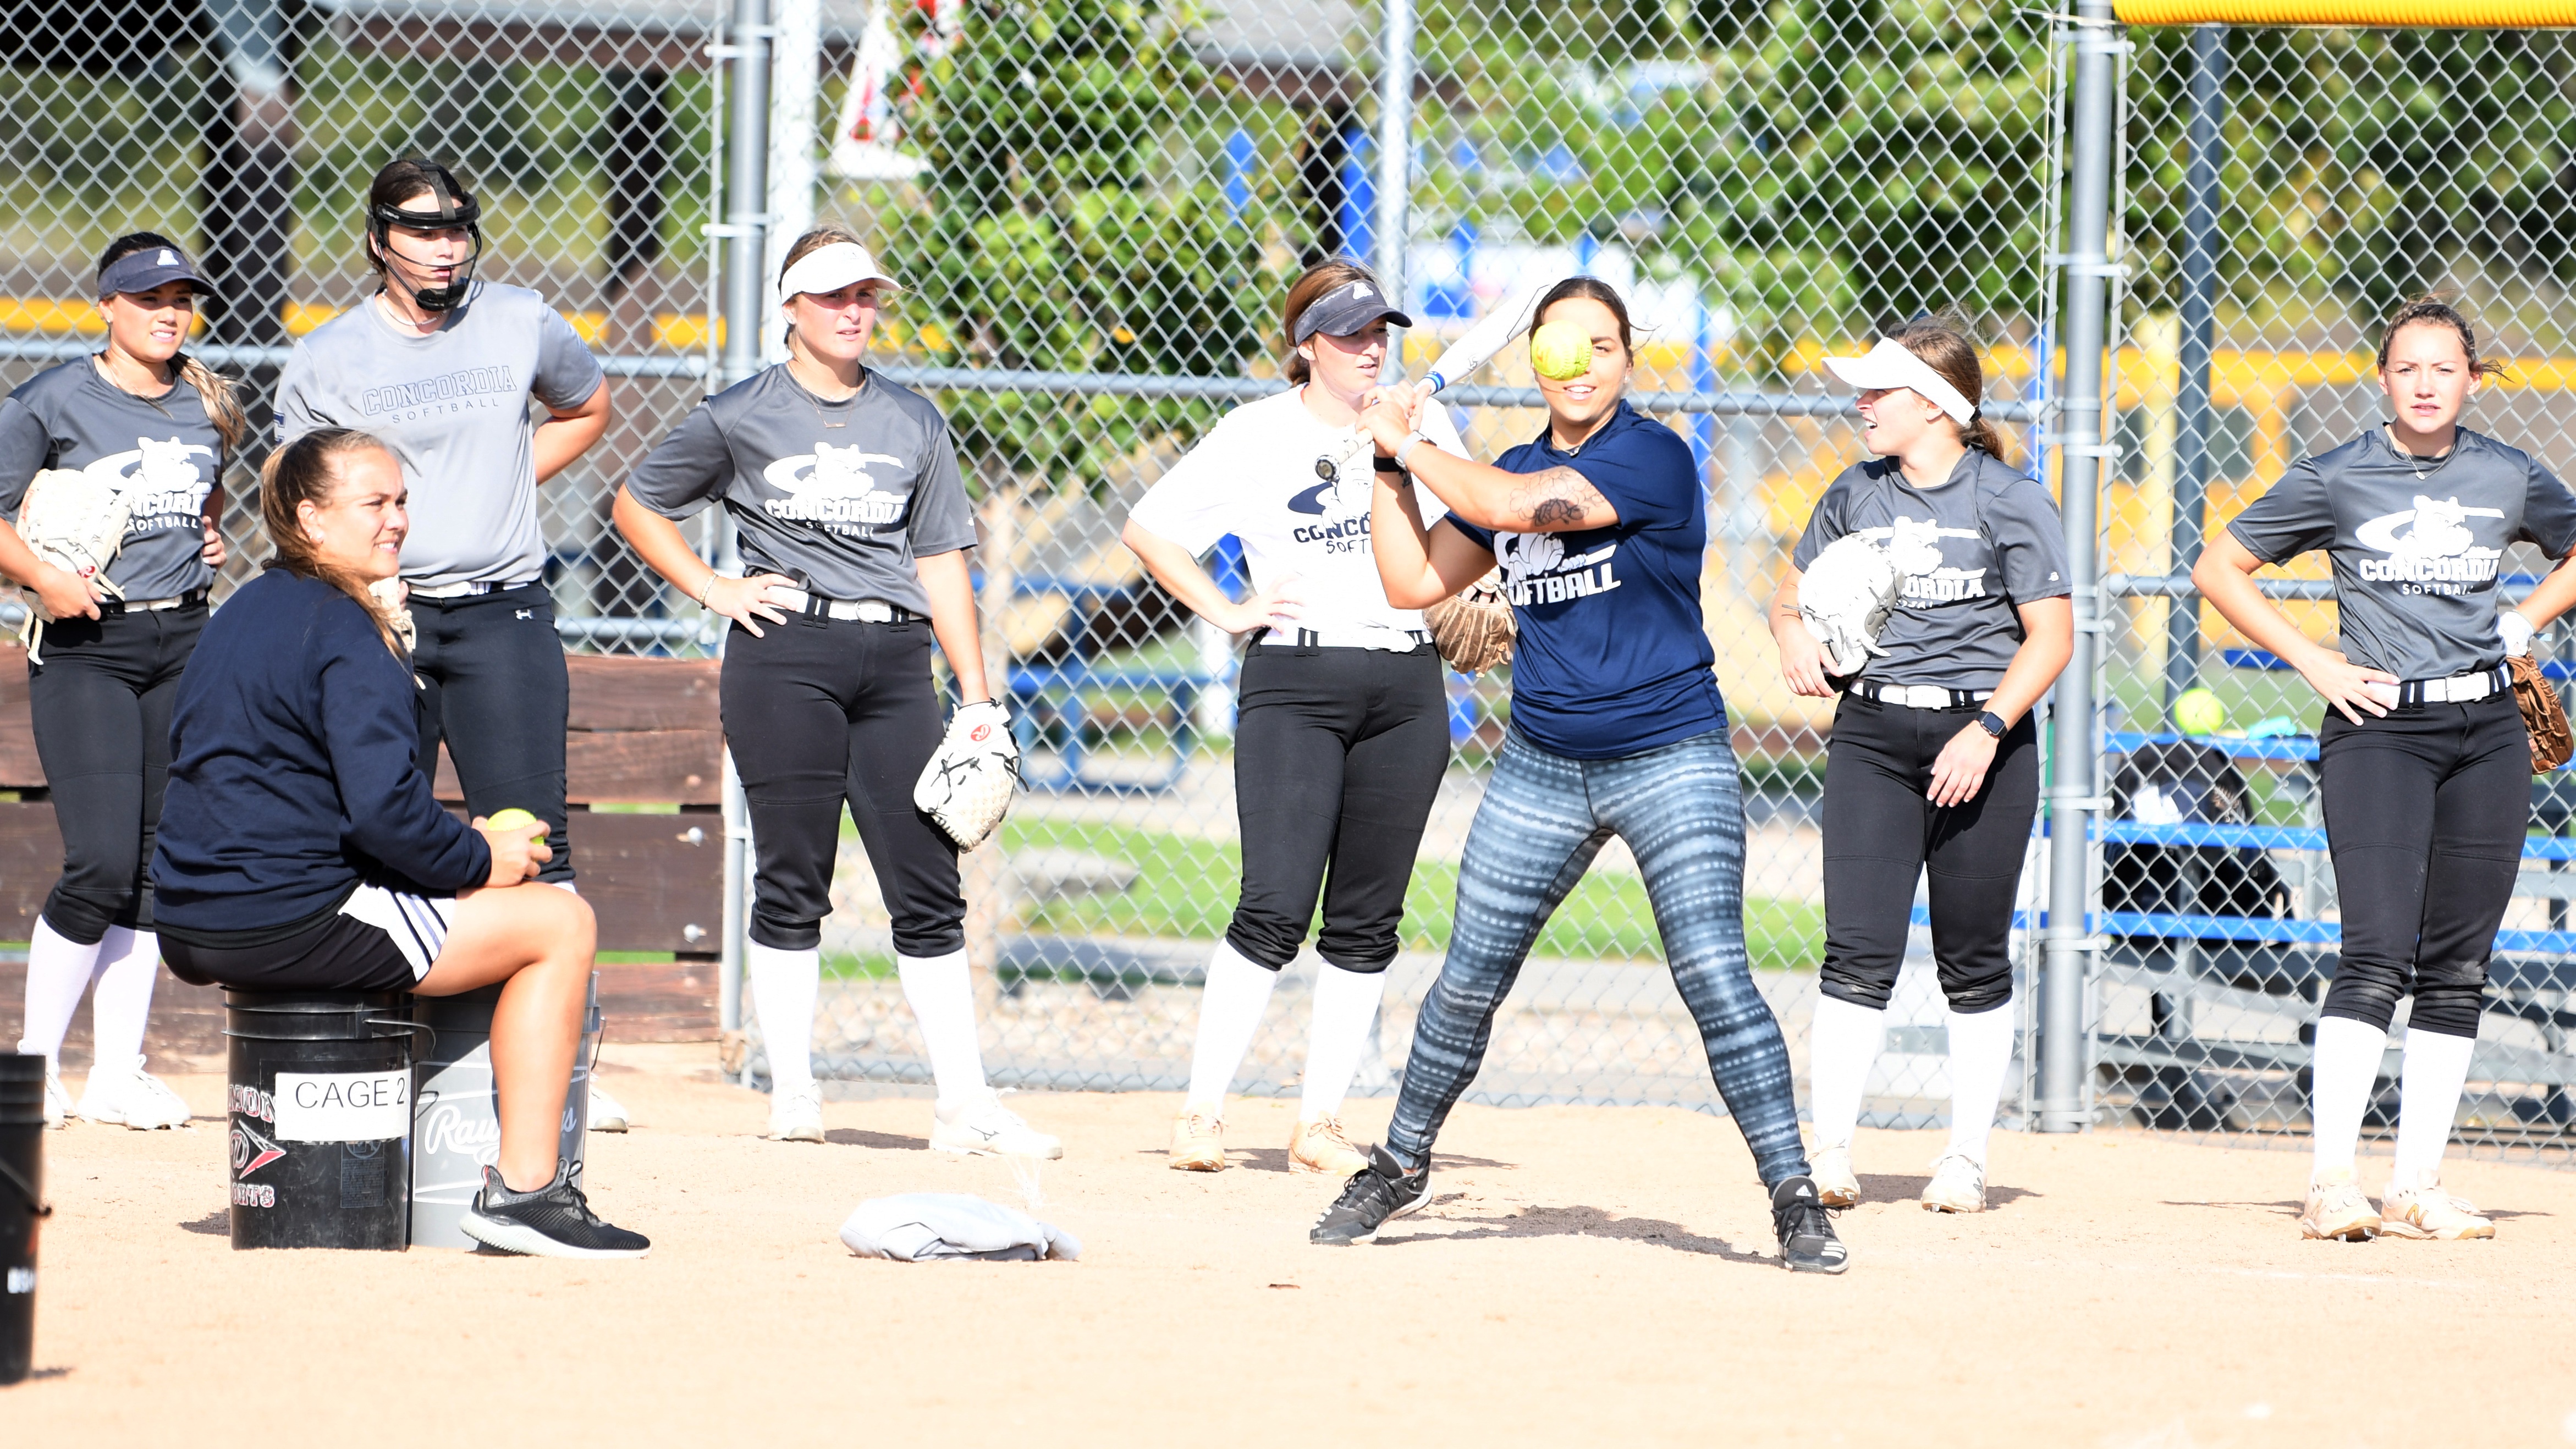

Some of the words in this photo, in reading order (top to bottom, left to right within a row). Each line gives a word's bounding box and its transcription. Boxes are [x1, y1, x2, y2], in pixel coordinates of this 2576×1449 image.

[362, 366, 518, 416] CONCORDIA
[392, 398, 499, 424] SOFTBALL
[128, 516, 198, 531] SOFTBALL
[764, 498, 904, 524] CONCORDIA
[2359, 557, 2500, 581] CONCORDIA
[295, 1079, 388, 1109] CAGE
[396, 1077, 406, 1105] 2
